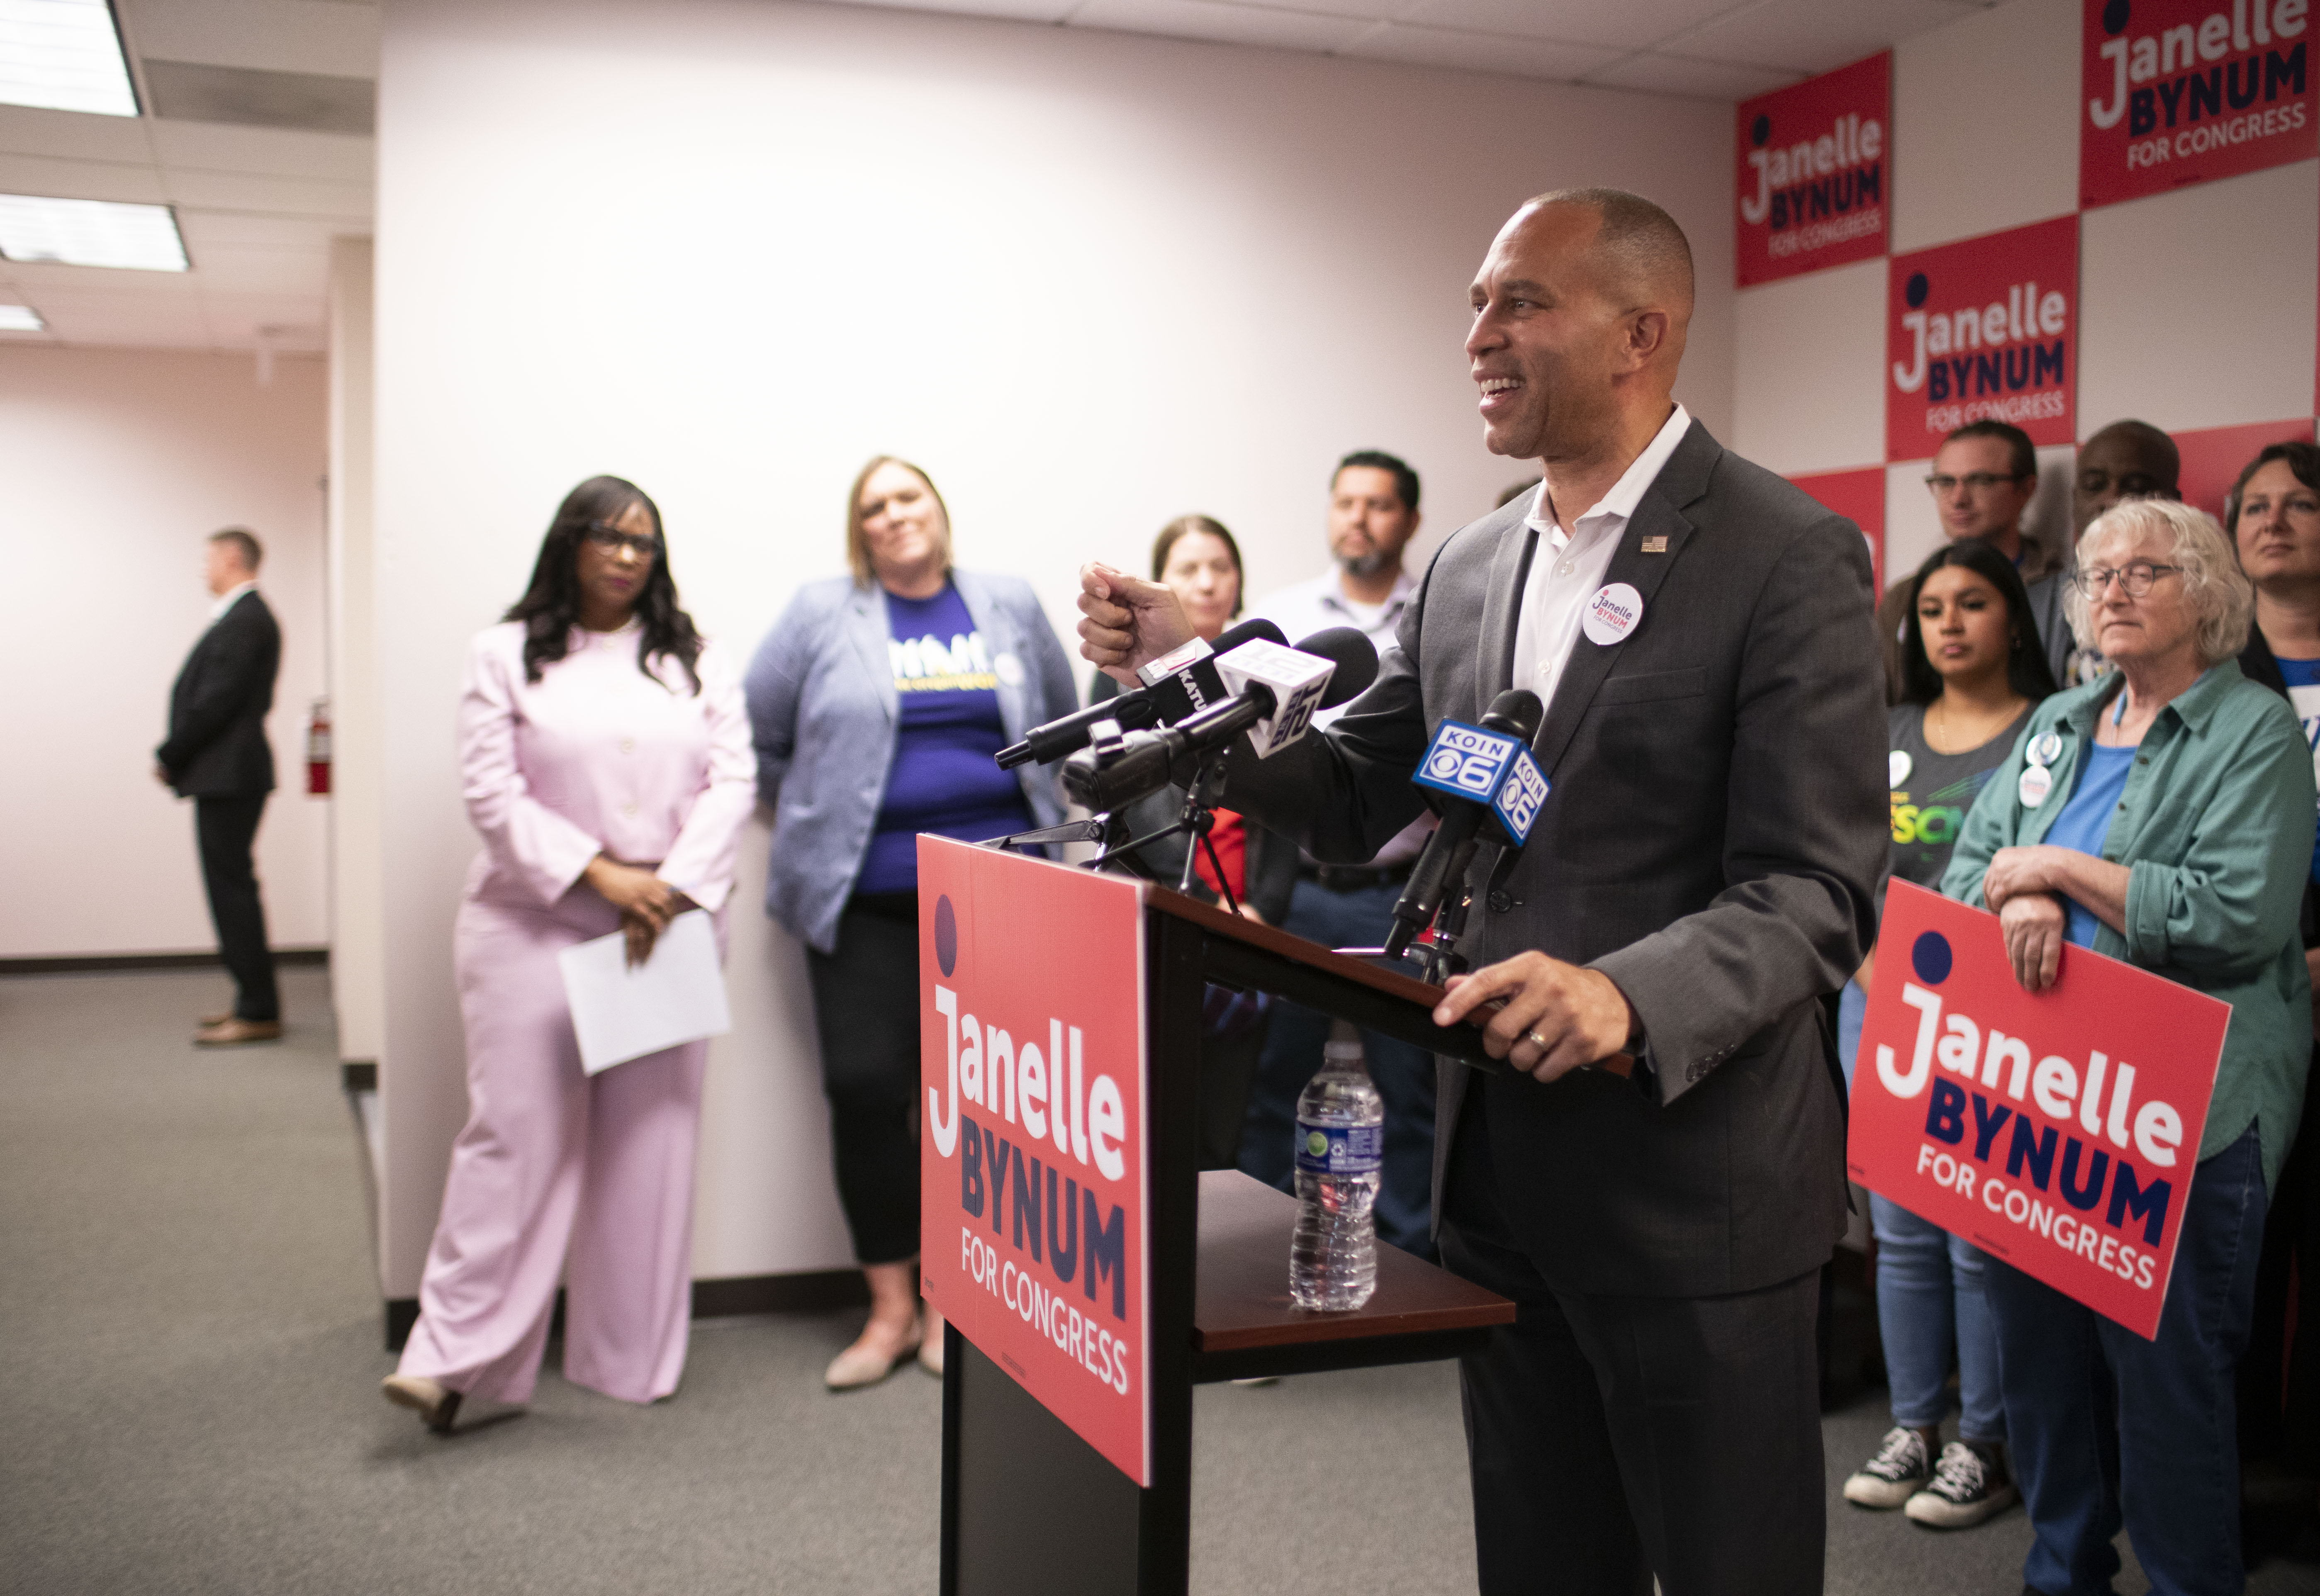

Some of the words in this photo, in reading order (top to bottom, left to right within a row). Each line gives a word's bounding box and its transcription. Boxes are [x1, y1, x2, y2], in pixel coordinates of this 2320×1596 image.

[2130, 42, 2306, 137] BYNUM
[2128, 137, 2170, 171] FOR
[2174, 102, 2306, 157] CONGRESS
[1771, 161, 1880, 230] BYNUM
[1929, 338, 2064, 402] BYNUM
[1926, 404, 1962, 433] FOR
[1597, 607, 1628, 629] BYNUM
[1602, 620, 1623, 634] CONGRESS
[1178, 669, 1207, 712] KATU
[1281, 674, 1328, 743] 12
[1445, 731, 1504, 756] KOIN
[1457, 756, 1496, 789] 6
[1518, 759, 1543, 800] KOIN
[1512, 793, 1535, 831] 6
[1924, 1076, 2172, 1248] BYNUM
[962, 1114, 1126, 1322] BYNUM
[1917, 1143, 1975, 1199] FOR
[1982, 1177, 2156, 1290] CONGRESS
[962, 1227, 997, 1297] FOR
[1002, 1261, 1127, 1395] CONGRESS
